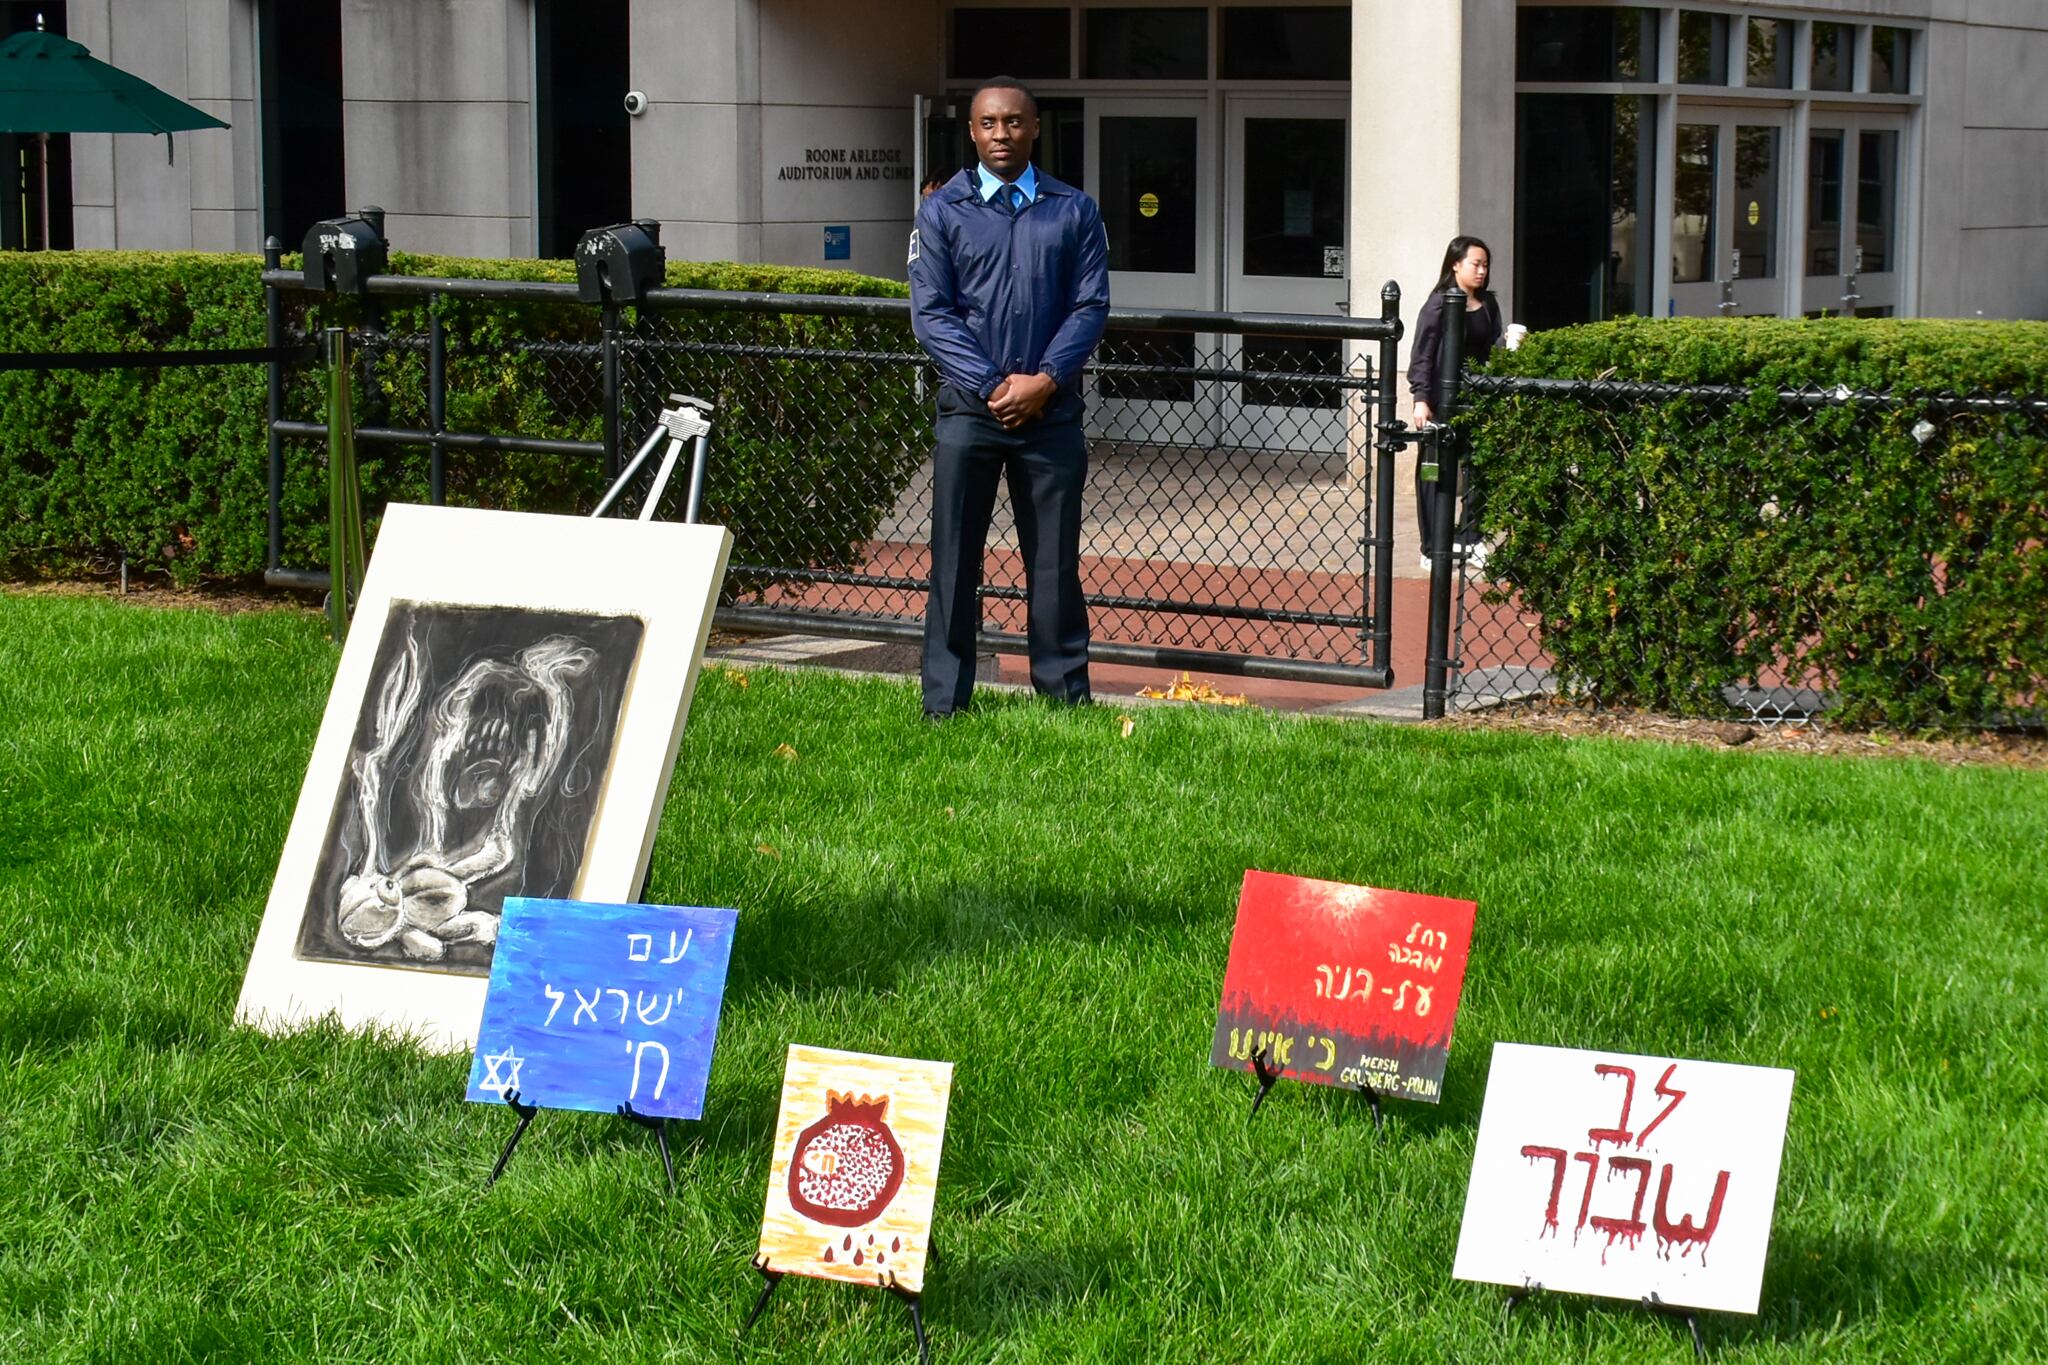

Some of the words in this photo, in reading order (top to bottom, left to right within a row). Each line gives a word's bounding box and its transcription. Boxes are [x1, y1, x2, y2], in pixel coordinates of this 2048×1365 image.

[778, 166, 852, 180] AUDITORIUM
[856, 166, 880, 180] AND
[882, 166, 914, 180] CINE
[805, 149, 846, 163] ROONE
[849, 149, 902, 163] ARLEDGE
[627, 928, 692, 964] עם
[1405, 922, 1447, 950] רחל
[1388, 943, 1442, 973] מבכה
[544, 984, 682, 1026] ישראל
[626, 1040, 669, 1100] חי
[1315, 1035, 1336, 1071] כי
[1588, 1063, 1686, 1151] לב
[1520, 1146, 1730, 1262] שבור
